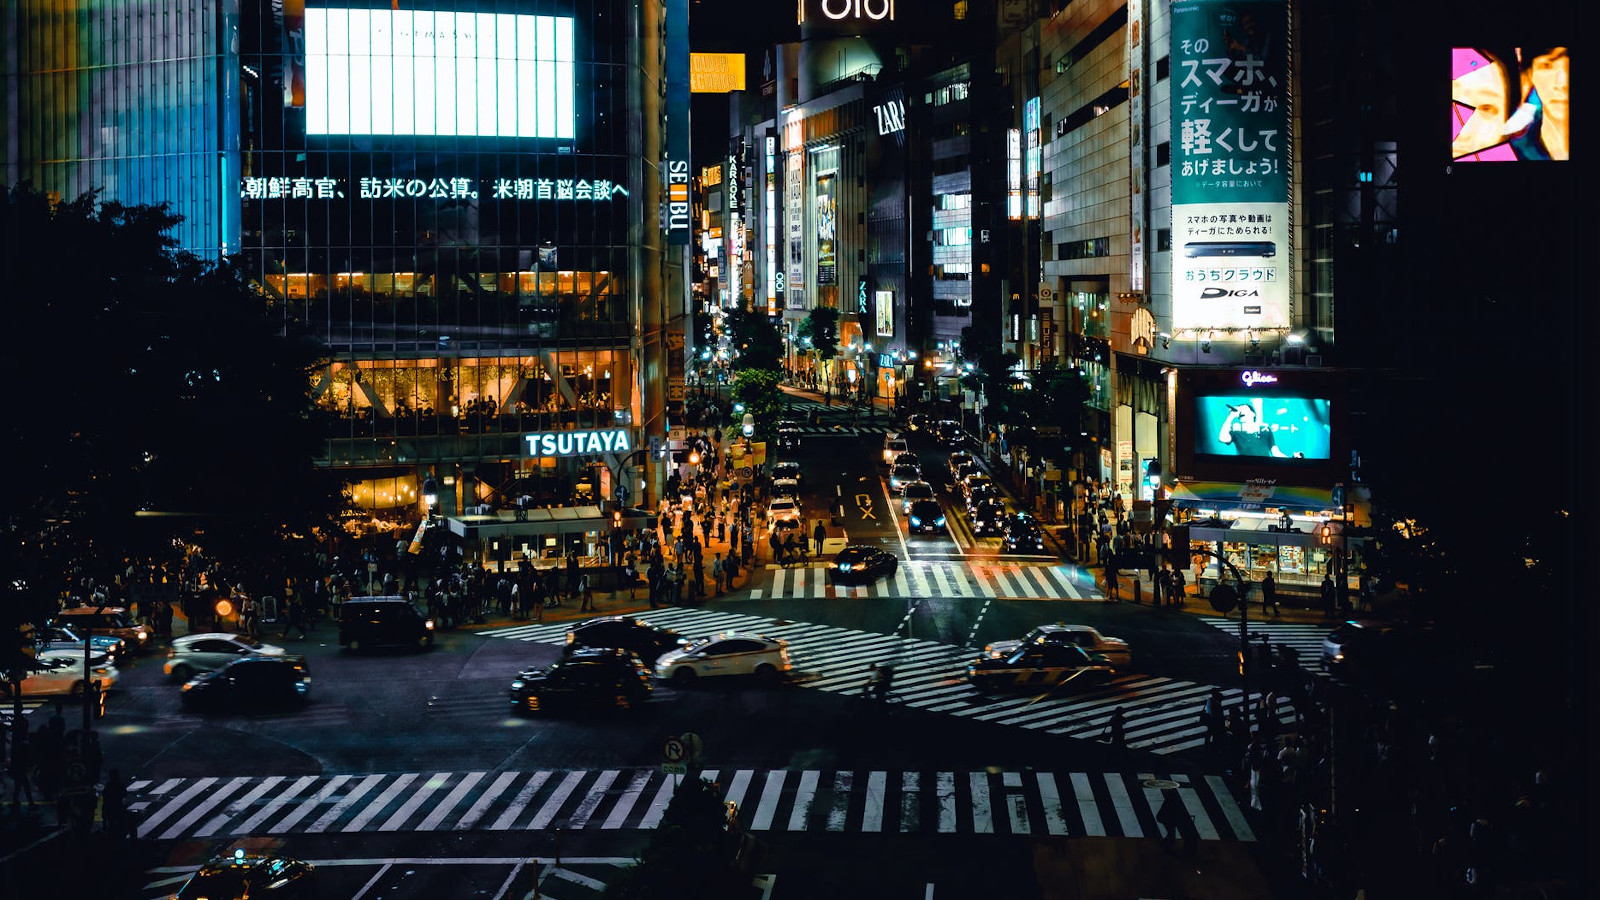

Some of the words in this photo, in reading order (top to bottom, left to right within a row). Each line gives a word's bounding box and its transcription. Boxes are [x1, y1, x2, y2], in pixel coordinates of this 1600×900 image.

[1181, 38, 1209, 55] その
[691, 71, 737, 90] ECORDS
[1181, 54, 1278, 89] スマホ、
[1181, 90, 1278, 115] ディーガが
[873, 99, 906, 136] ZARA
[1181, 118, 1278, 156] 軽くして
[1181, 158, 1278, 177] あげましょう!
[240, 176, 629, 201] 朝鮮高官、訪米の公算。米朝首脳会談へ
[729, 155, 739, 209] KARAOKE
[669, 160, 688, 230] SEIBU
[1187, 214, 1272, 224] スマホの写真や動画は
[1187, 226, 1272, 236] ディーガにためられる!
[1186, 269, 1275, 281] おうちクラウド
[858, 281, 867, 314] ZARA
[1200, 287, 1259, 299] DIGA
[525, 430, 631, 456] TSUTAYA
